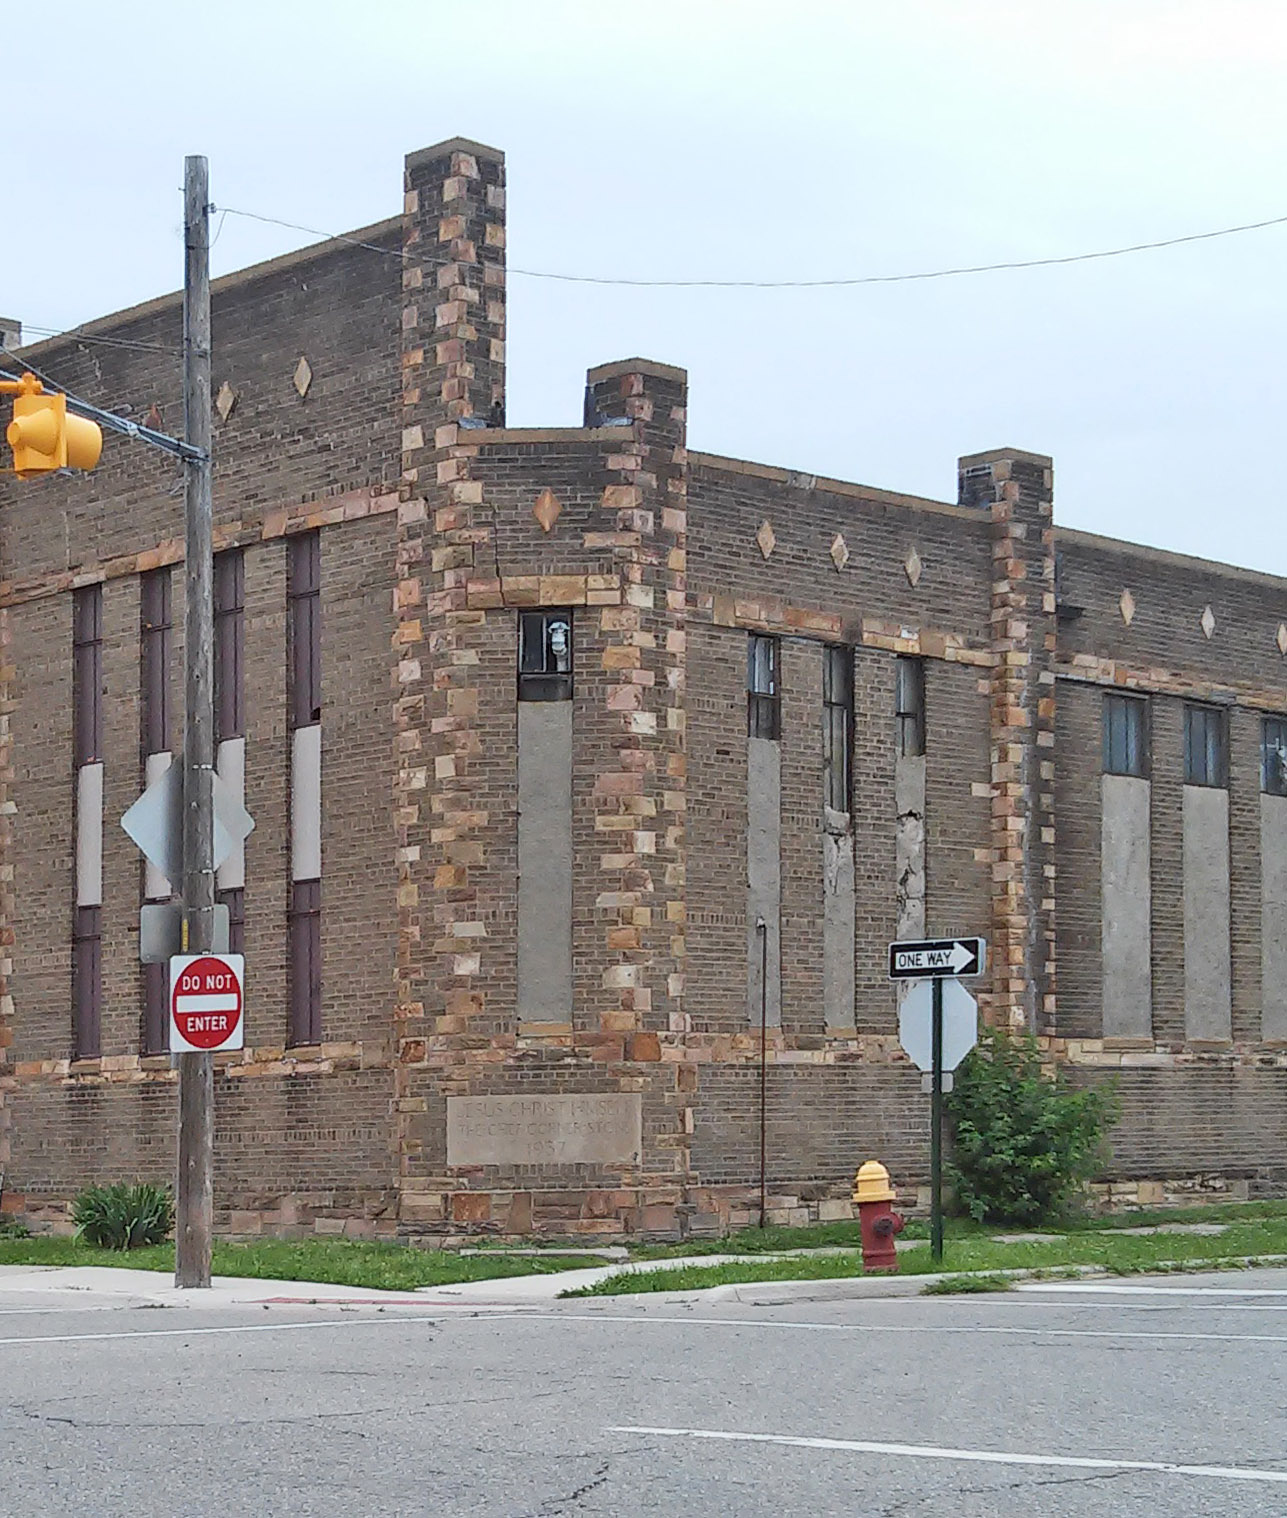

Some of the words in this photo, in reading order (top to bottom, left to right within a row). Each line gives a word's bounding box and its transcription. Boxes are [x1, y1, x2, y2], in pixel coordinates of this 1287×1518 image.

[898, 953, 923, 968] ONE
[926, 951, 952, 966] WAY
[182, 975, 200, 991] DO
[206, 974, 232, 989] NOT
[187, 1015, 228, 1032] ENTER
[509, 1101, 567, 1117] CHRIST
